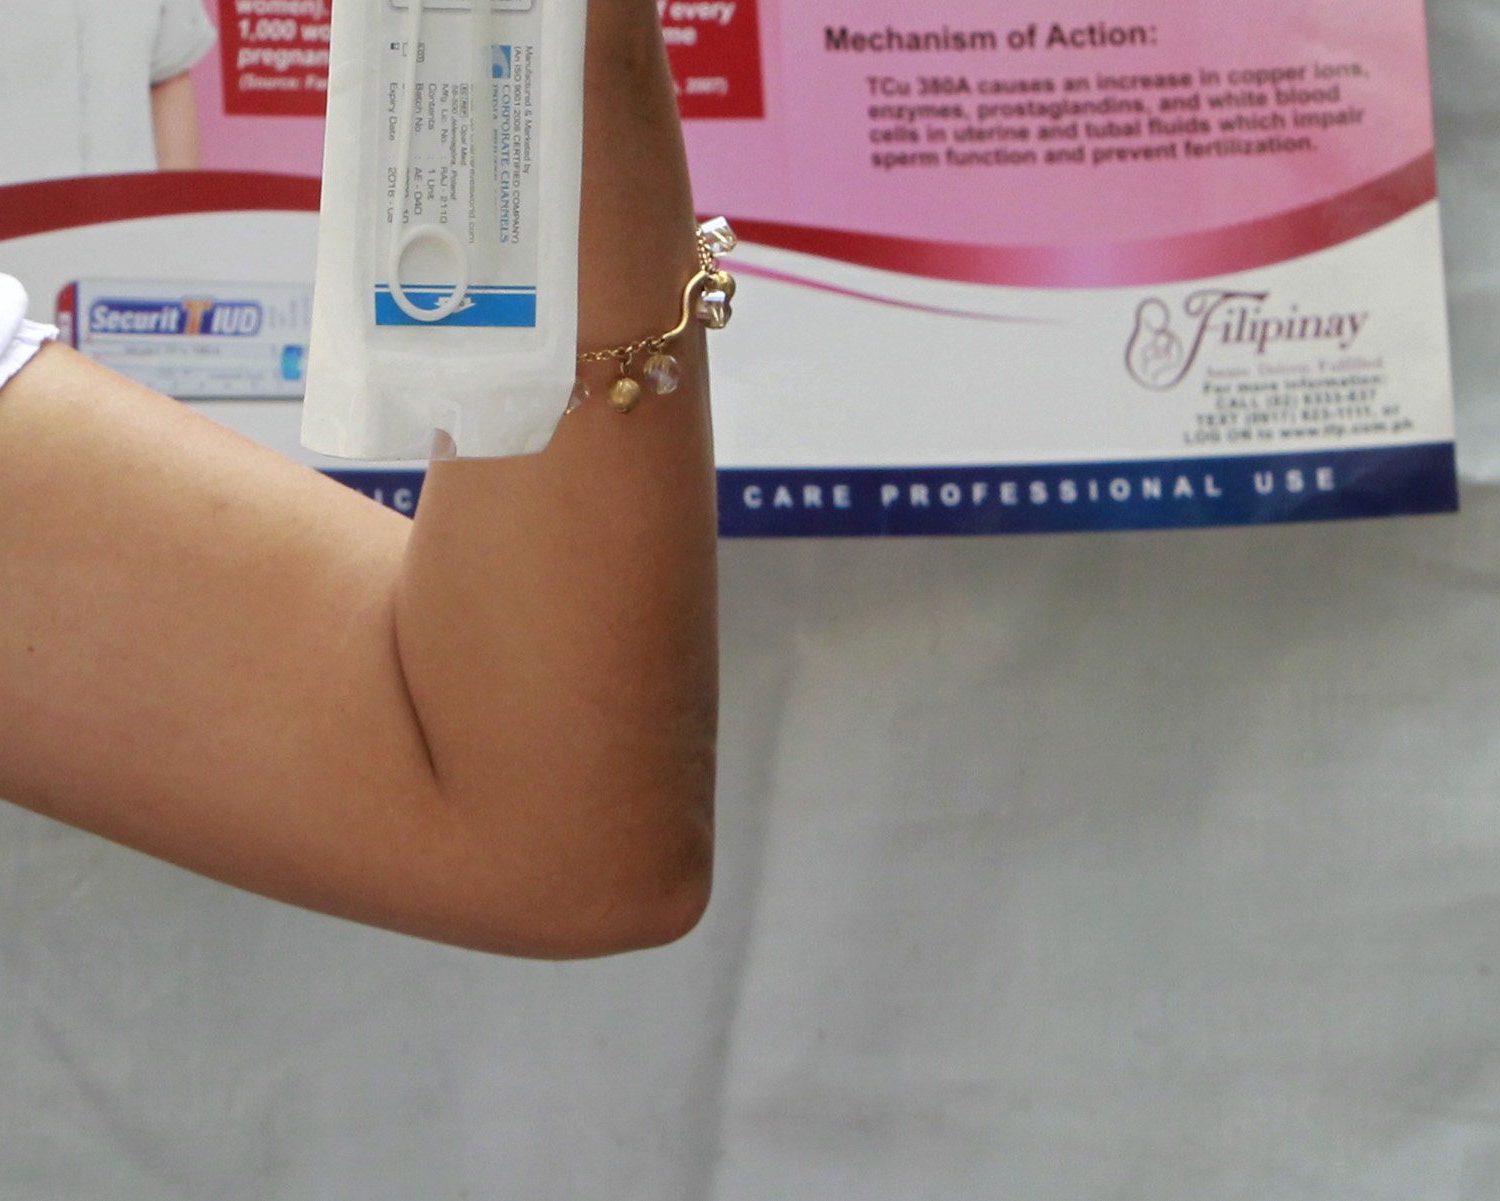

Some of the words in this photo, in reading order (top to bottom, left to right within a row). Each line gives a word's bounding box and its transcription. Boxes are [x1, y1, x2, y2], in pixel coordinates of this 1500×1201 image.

[669, 0, 737, 26] every
[238, 18, 298, 42] 1,000
[824, 26, 997, 54] Mechanism
[1007, 24, 1038, 50] of
[1046, 21, 1158, 49] Action:
[513, 46, 521, 61] (An
[513, 64, 521, 82] ISO
[525, 46, 533, 107] Manufactured
[868, 76, 911, 98] TCu
[917, 75, 970, 97] 380A
[978, 78, 1055, 96] causes
[1063, 76, 1090, 94] an
[1097, 69, 1192, 92] increase
[1200, 67, 1220, 87] in
[1227, 65, 1307, 88] copper
[388, 82, 399, 113] Expiry
[414, 82, 424, 114] Batch
[428, 82, 437, 130] Contents
[868, 101, 968, 123] enzymes,
[978, 96, 1151, 122] prostaglandins,
[1159, 93, 1200, 112] and
[1208, 87, 1270, 110] white
[1275, 83, 1341, 105] blood
[389, 116, 398, 141] Date
[500, 83, 510, 166] CORPORATE
[524, 119, 532, 161] Marketed
[869, 124, 920, 145] cells
[926, 123, 947, 144] in
[953, 121, 1030, 143] uterine
[1037, 120, 1079, 141] and
[1085, 116, 1142, 139] tubal
[1148, 114, 1211, 137] fluids
[1218, 111, 1286, 132] which
[1293, 106, 1364, 132] impair
[512, 134, 521, 188] CERTIFIED
[871, 148, 940, 171] sperm
[946, 144, 1036, 167] function
[1043, 143, 1085, 164] and
[1092, 140, 1177, 165] prevent
[1184, 133, 1318, 159] fertilization.
[414, 166, 423, 181] AE
[440, 166, 448, 186] RAJ
[522, 164, 531, 174] by
[414, 191, 422, 215] 040
[427, 179, 435, 200] Unit
[439, 195, 448, 224] 2110
[500, 170, 510, 243] CHANNELS
[511, 190, 520, 244] COMPANY)
[211, 304, 257, 334] IUD
[1184, 289, 1370, 354] Filipinay
[743, 483, 852, 509] CARE
[881, 474, 1224, 510] PROFESSIONAL
[1253, 467, 1337, 495] USE
